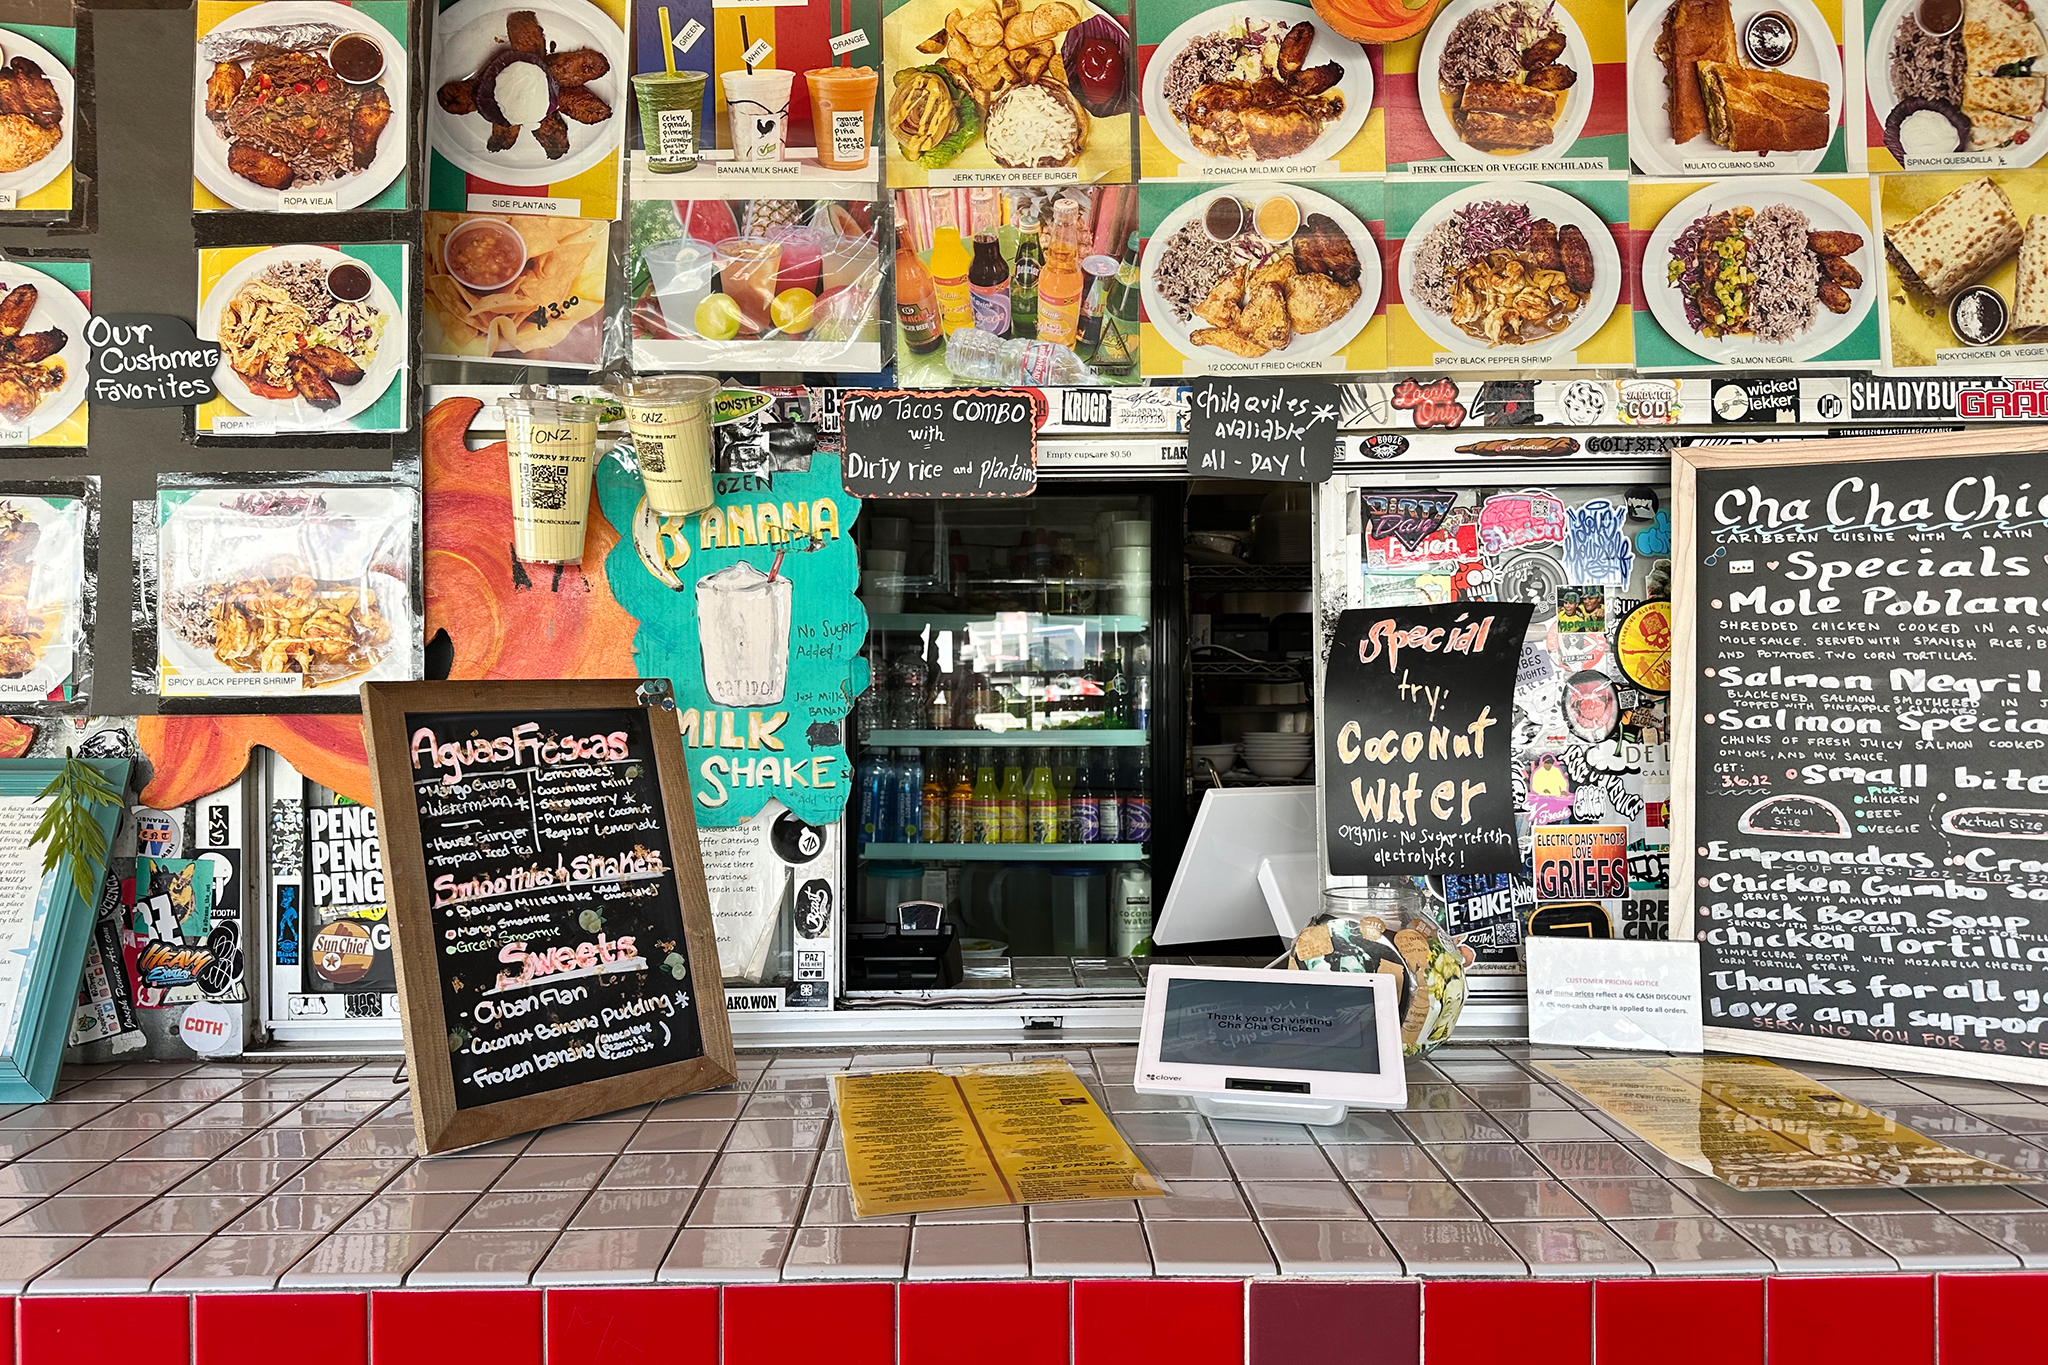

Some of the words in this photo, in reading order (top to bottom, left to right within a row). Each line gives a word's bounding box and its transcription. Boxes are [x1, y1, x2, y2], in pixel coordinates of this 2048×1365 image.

[679, 23, 700, 46] GREEN
[832, 34, 865, 49] ORANGE
[747, 42, 768, 64] WHITE
[772, 166, 799, 174] SHAKE
[1412, 165, 1437, 174] JERK
[1440, 165, 1481, 173] CHICKEN
[1486, 164, 1500, 172] OR
[1502, 163, 1538, 171] VEGGIE
[1542, 162, 1603, 170] ENCHILADAS
[1684, 162, 1717, 170] MULATO
[1718, 161, 1751, 169] CUBANO
[1907, 158, 1942, 166] SPINACH
[1943, 156, 1993, 165] QUESADILLA
[952, 173, 974, 182] JERK
[975, 173, 1006, 182] TURKEY
[1008, 173, 1019, 181] OR
[1022, 172, 1042, 181] BEEF
[1044, 171, 1078, 180] BURGER
[284, 197, 309, 206] ROPA
[311, 196, 333, 206] VIEJA
[492, 200, 509, 209] SIDE
[512, 201, 556, 210] PLANTAINS
[88, 316, 152, 347] Our
[101, 344, 219, 374] Customers
[1262, 362, 1284, 370] FRIED
[1286, 361, 1322, 369] CHICKEN
[1765, 356, 1794, 364] NEGRIL
[1398, 381, 1454, 405] Locals
[1626, 389, 1672, 400] SANDWICH
[1747, 378, 1797, 395] wicked
[844, 398, 882, 423] Two
[888, 395, 943, 420] Tacos
[1629, 400, 1673, 416] GOD!
[1750, 394, 1794, 411] lekker
[1416, 399, 1463, 427] Only
[908, 425, 945, 442] with
[1377, 435, 1403, 446] BOOZE
[1046, 451, 1072, 459] Empty
[849, 453, 902, 484] Dirty
[908, 461, 943, 481] rice
[953, 461, 973, 475] and
[1714, 485, 1811, 528] Cha
[1826, 476, 1934, 527] Cha
[1716, 533, 1819, 544] CARIBBEAN
[1833, 532, 1895, 542] CUISINE
[1908, 532, 1946, 542] WITH
[1962, 531, 1972, 539] A
[1983, 529, 2032, 539] LATIN
[1784, 546, 2030, 592] Specials
[1729, 585, 1842, 616] Mole
[798, 625, 815, 638] No
[822, 620, 859, 641] Sugar
[1359, 612, 1495, 673] Special
[1718, 651, 1745, 660] AND
[1757, 650, 1821, 660] POTATOES.
[1825, 651, 1856, 660] TWO
[1863, 651, 1896, 661] CORN
[1903, 651, 1978, 661] TORTILLAS.
[1717, 665, 1873, 691] Salmon
[697, 755, 837, 808] SHAKE
[1801, 763, 1928, 787] Small
[537, 782, 597, 795] Cucumber
[601, 777, 633, 788] Mint
[544, 809, 605, 824] Pineapple
[609, 803, 652, 818] Coconut
[1539, 807, 1570, 823] Fresh
[1770, 805, 1813, 817] Actual
[1774, 817, 1801, 827] Size
[1464, 827, 1512, 845] refresh
[1537, 834, 1572, 847] ELECTRIC
[1575, 833, 1598, 846] DAISY
[1599, 833, 1625, 845] THOTS
[715, 849, 736, 857] patio
[1571, 847, 1592, 859] LOVE
[1707, 841, 1934, 869] Empanadas
[1540, 858, 1626, 898] GRIEFS
[1708, 872, 1851, 894] Chicken
[1861, 875, 1988, 900] Gumbo
[1711, 903, 1807, 922] Black
[1817, 906, 1917, 927] Bean
[1927, 908, 2030, 937] Soup
[276, 950, 298, 958] Black
[316, 935, 337, 952] Sun
[340, 936, 369, 955] Chief
[143, 943, 213, 976] HEAVY
[498, 933, 638, 982] Sweets
[1708, 969, 1857, 997] Thanks
[1865, 974, 1938, 998] for
[1942, 978, 2006, 1002] all
[474, 995, 538, 1024] Cuban
[539, 985, 588, 1009] Flan
[1656, 993, 1691, 1001] DISCOUNT
[1207, 1012, 1243, 1022] Thank
[1244, 1014, 1267, 1024] you
[1268, 1014, 1286, 1023] for
[1289, 1016, 1333, 1027] visiting
[1710, 996, 1798, 1021] Love
[1813, 1002, 1896, 1028] and
[184, 1017, 223, 1036] COTH
[471, 1030, 534, 1055] Coconut
[535, 1015, 599, 1041] Banana
[601, 994, 674, 1027] Pudding
[1218, 1020, 1241, 1029] Cha
[1244, 1022, 1268, 1030] Cha
[1271, 1023, 1321, 1033] Chicken
[1156, 1074, 1182, 1082] clover
